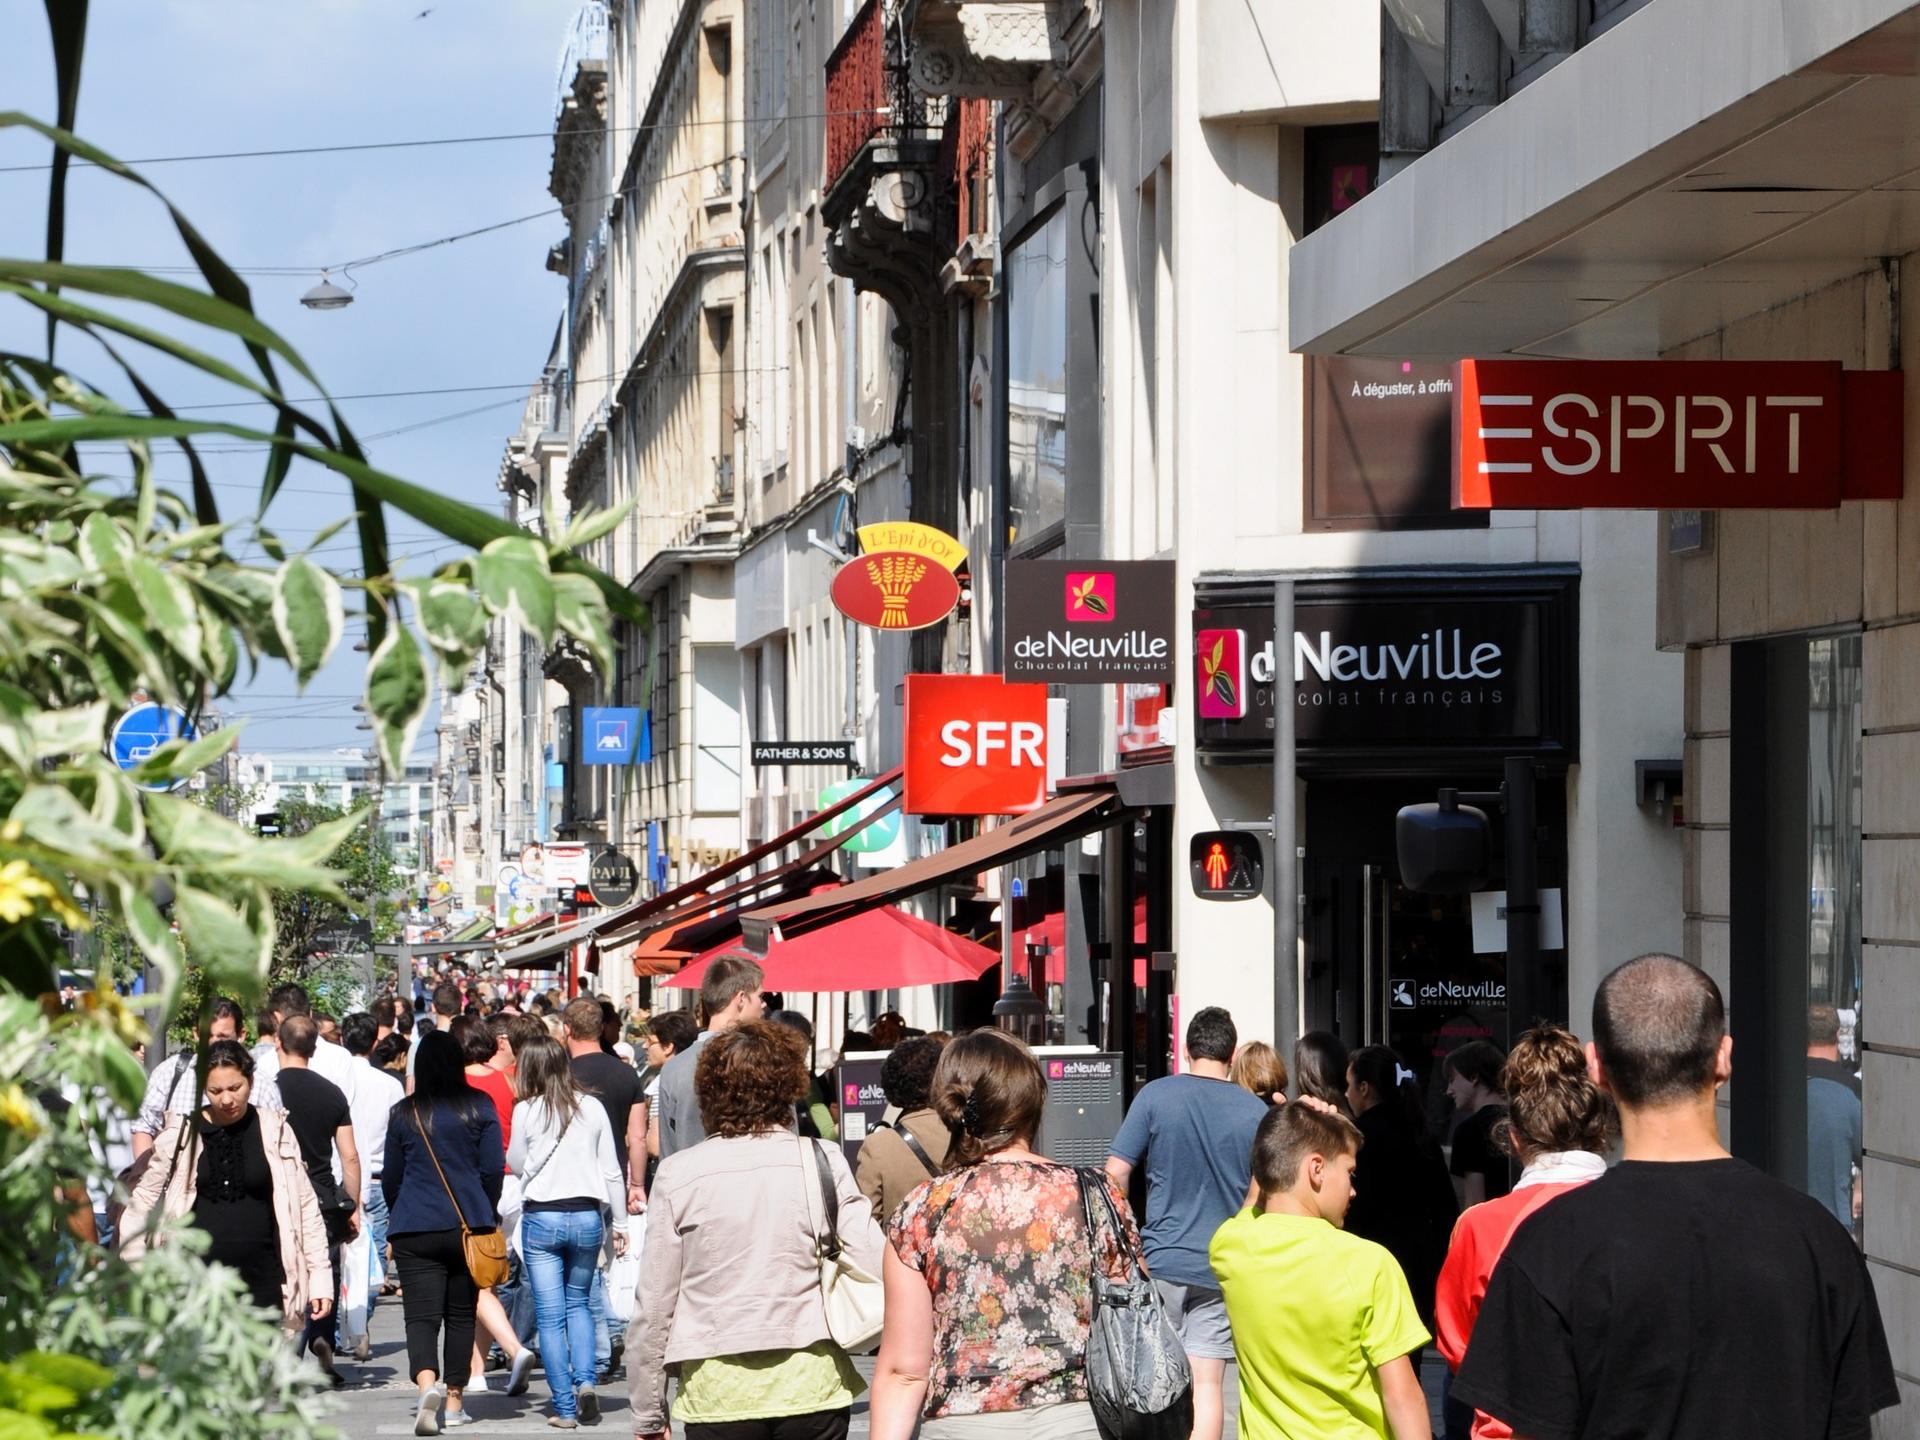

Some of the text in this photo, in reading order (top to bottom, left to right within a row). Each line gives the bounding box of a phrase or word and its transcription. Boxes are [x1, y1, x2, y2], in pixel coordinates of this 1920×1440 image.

[1363, 382, 1416, 398] déguster,
[1418, 381, 1426, 393] à
[1478, 393, 1824, 475] ESPRIT
[1014, 630, 1168, 658] deNeuville
[1250, 628, 1502, 682] dNeuville
[1014, 660, 1167, 673] Chocolat français
[1256, 687, 1503, 708] Ccolat français
[755, 747, 846, 759] FATHER & SONS
[940, 720, 1045, 768] SFR
[1420, 981, 1506, 998] deNeuville
